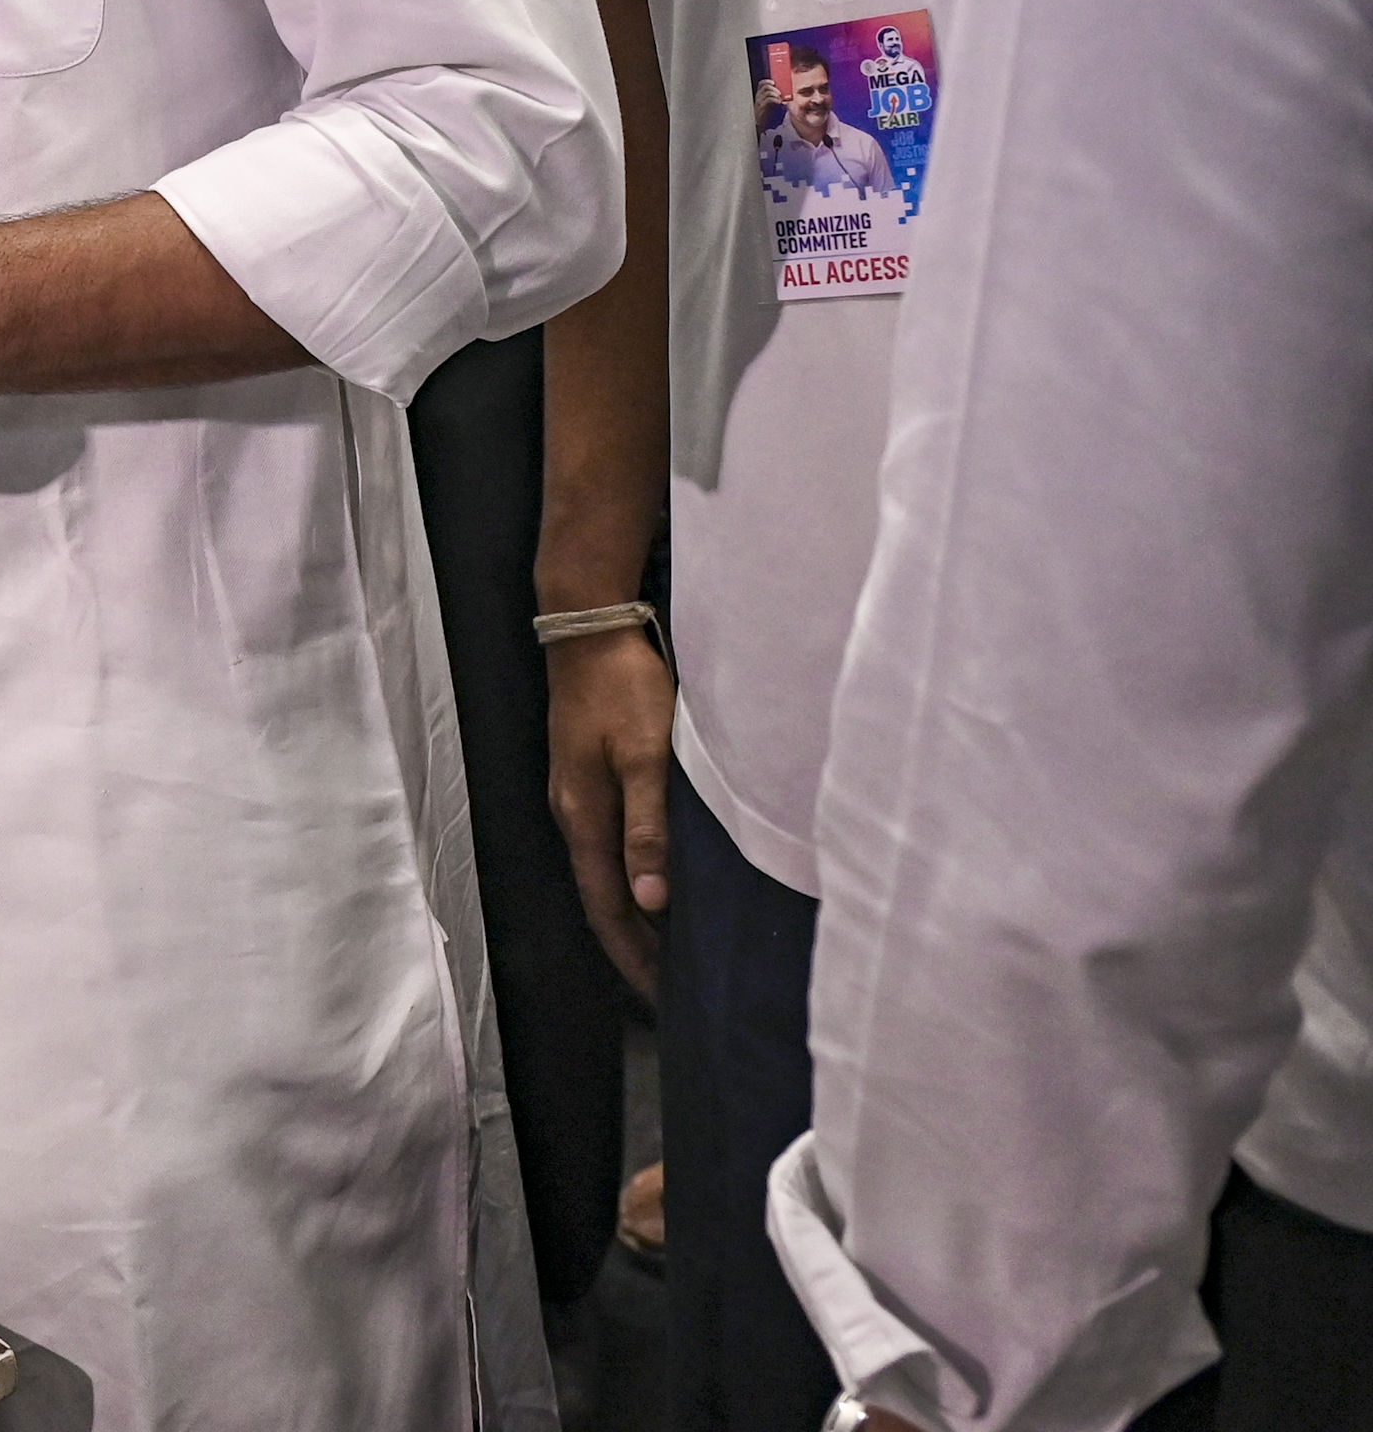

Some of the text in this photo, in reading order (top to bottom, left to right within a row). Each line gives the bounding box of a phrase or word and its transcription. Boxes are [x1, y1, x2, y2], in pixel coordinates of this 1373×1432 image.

[869, 69, 924, 89] MEGA
[868, 84, 932, 117] JOB
[878, 112, 919, 128] FAIR
[775, 213, 871, 237] ORGANIZING
[777, 231, 867, 254] COMMITTEE
[783, 255, 909, 287] ALL ACCESS
